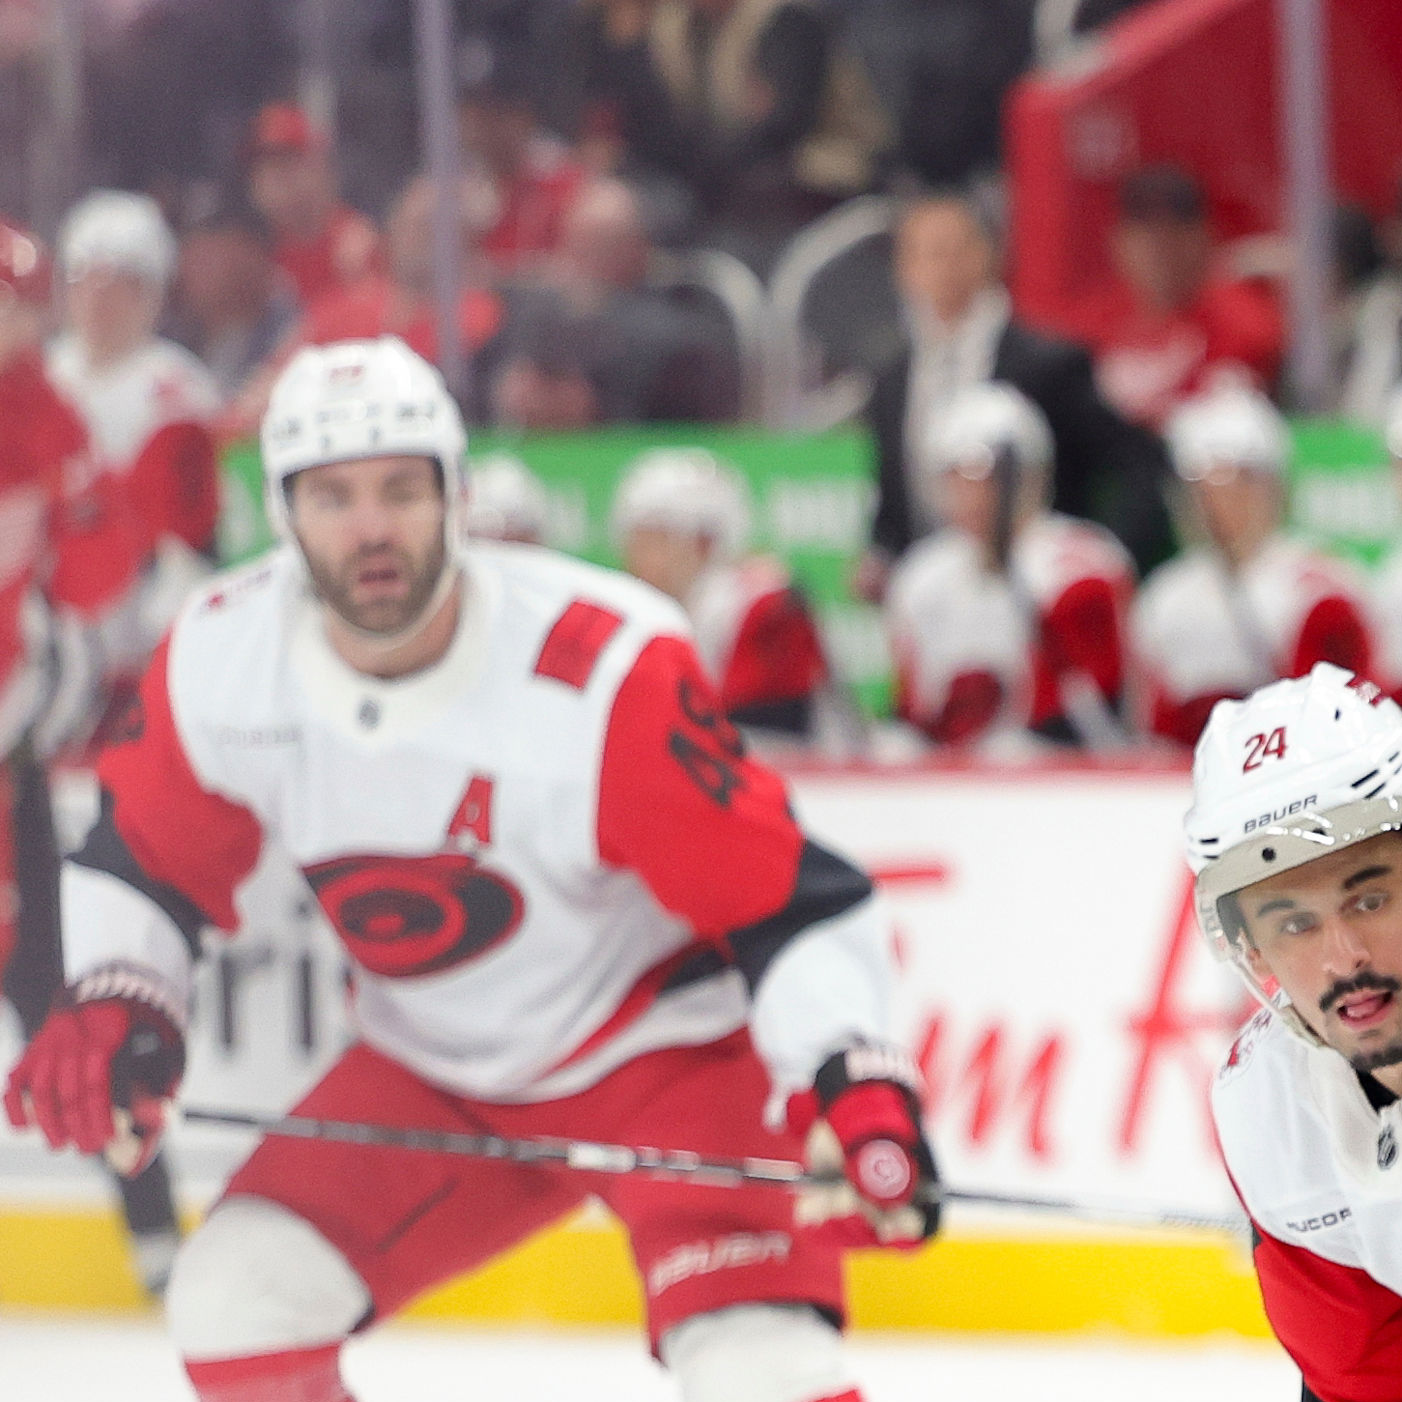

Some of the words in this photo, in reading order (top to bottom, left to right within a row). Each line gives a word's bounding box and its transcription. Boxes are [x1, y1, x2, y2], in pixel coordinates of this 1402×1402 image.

[1242, 726, 1289, 776] 24
[449, 774, 494, 846] A
[1243, 794, 1319, 835] BAUER
